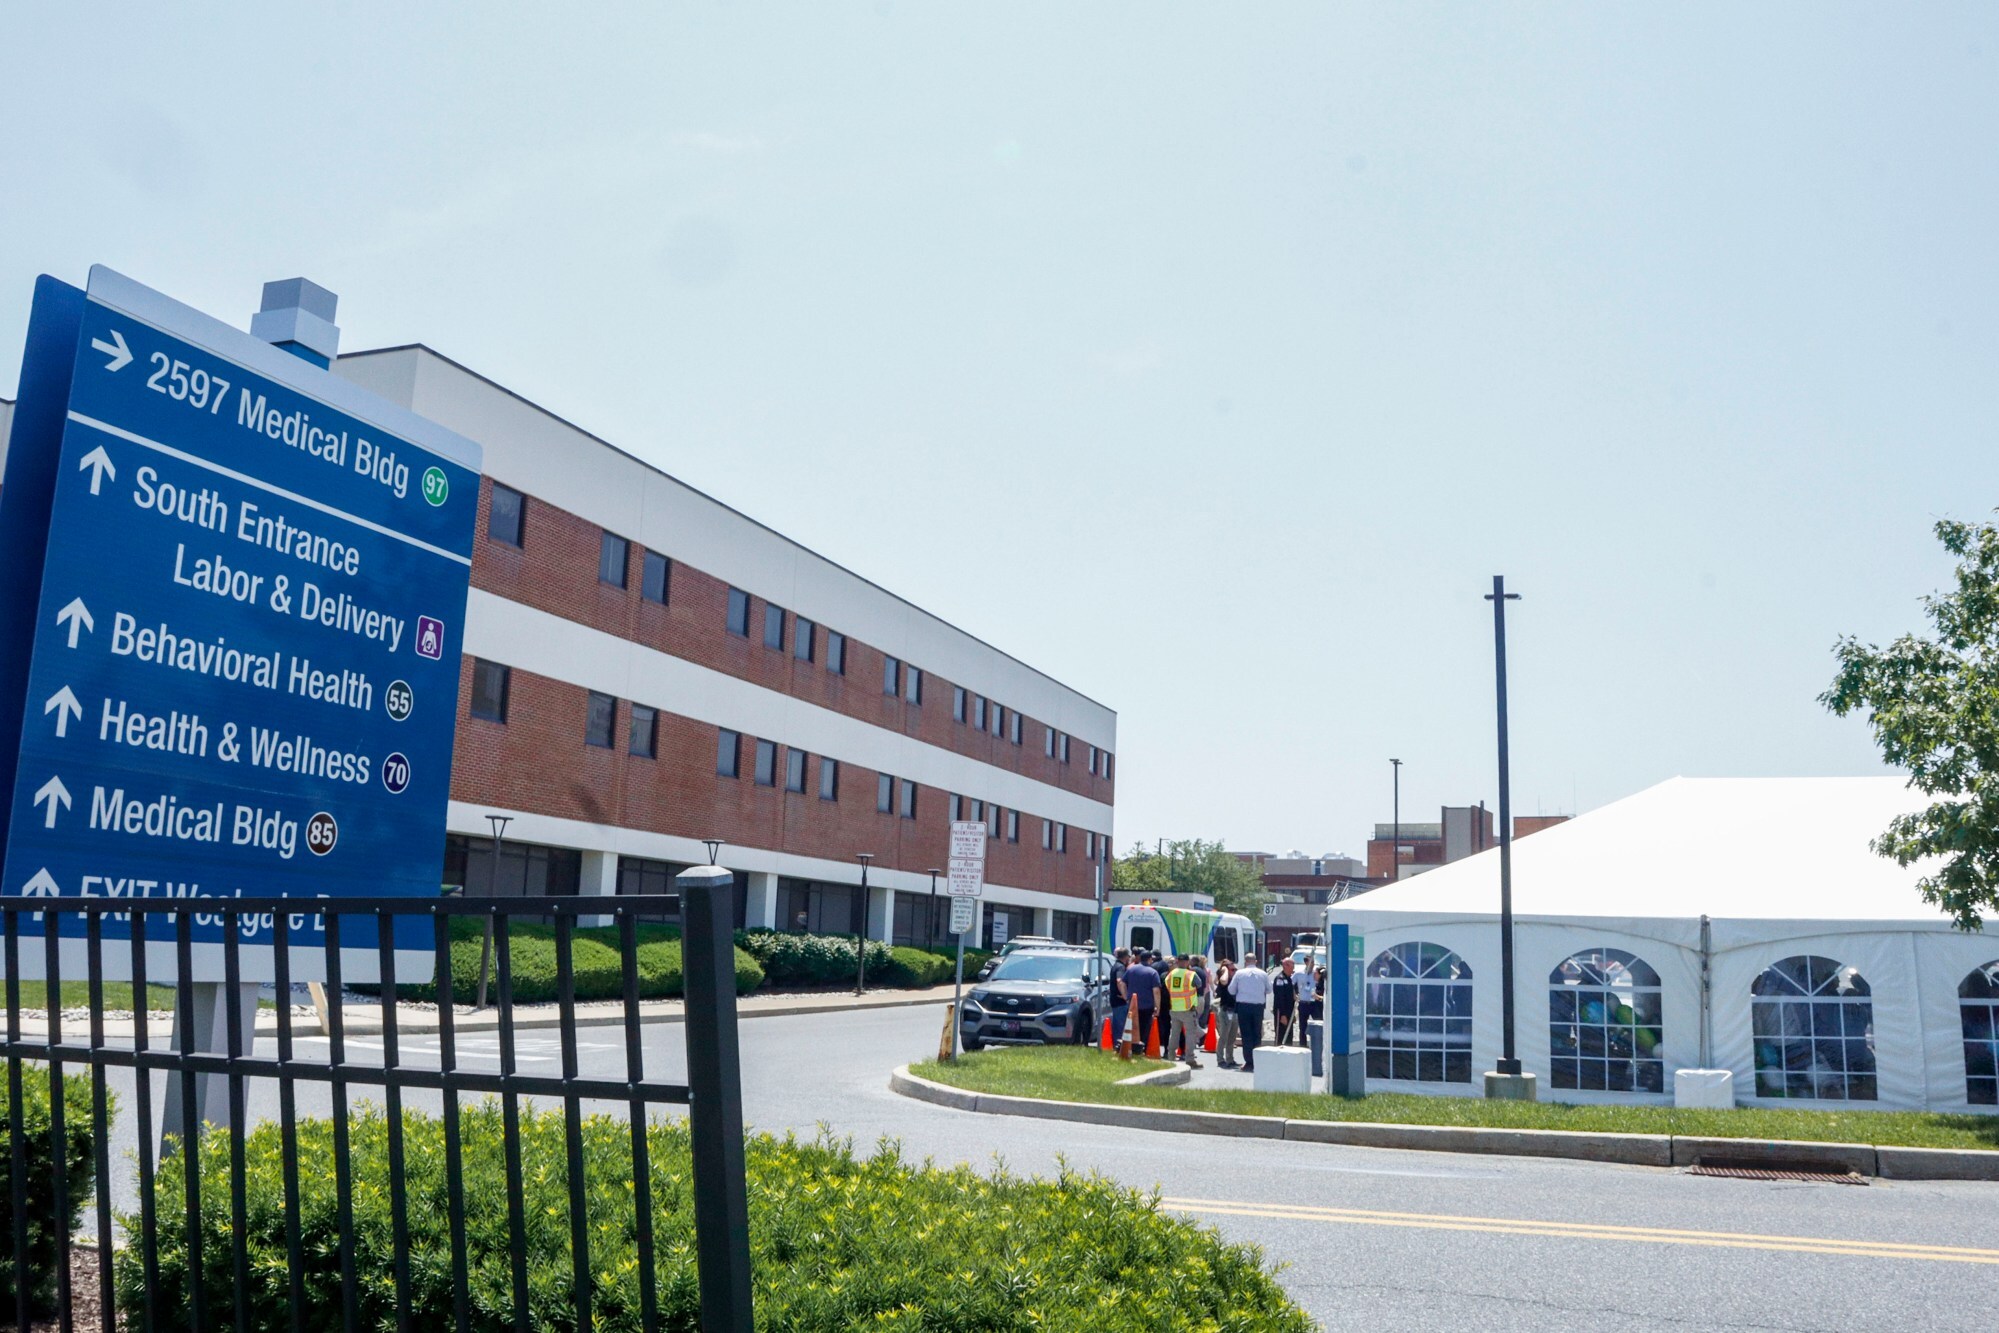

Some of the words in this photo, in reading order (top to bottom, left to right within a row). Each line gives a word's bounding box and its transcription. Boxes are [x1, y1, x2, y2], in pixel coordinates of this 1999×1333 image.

[146, 351, 230, 415] 2597
[238, 388, 348, 466] Medical
[354, 438, 409, 499] Bldg
[425, 473, 446, 498] 97
[133, 466, 228, 533] South
[237, 501, 360, 576] Entrance
[173, 543, 263, 604] Labor
[270, 574, 292, 615] &
[300, 582, 405, 653] Delivery
[111, 611, 280, 690] Behavioral
[288, 656, 373, 711] Health
[388, 688, 410, 713] 55
[100, 698, 208, 757] Health
[217, 721, 241, 763] &
[251, 726, 370, 784] Wellness
[387, 761, 407, 785] 70
[89, 786, 224, 842] Medical
[232, 805, 298, 859] Bldg
[309, 821, 334, 846] 85
[78, 875, 158, 922] EXIT
[1265, 905, 1276, 915] 87
